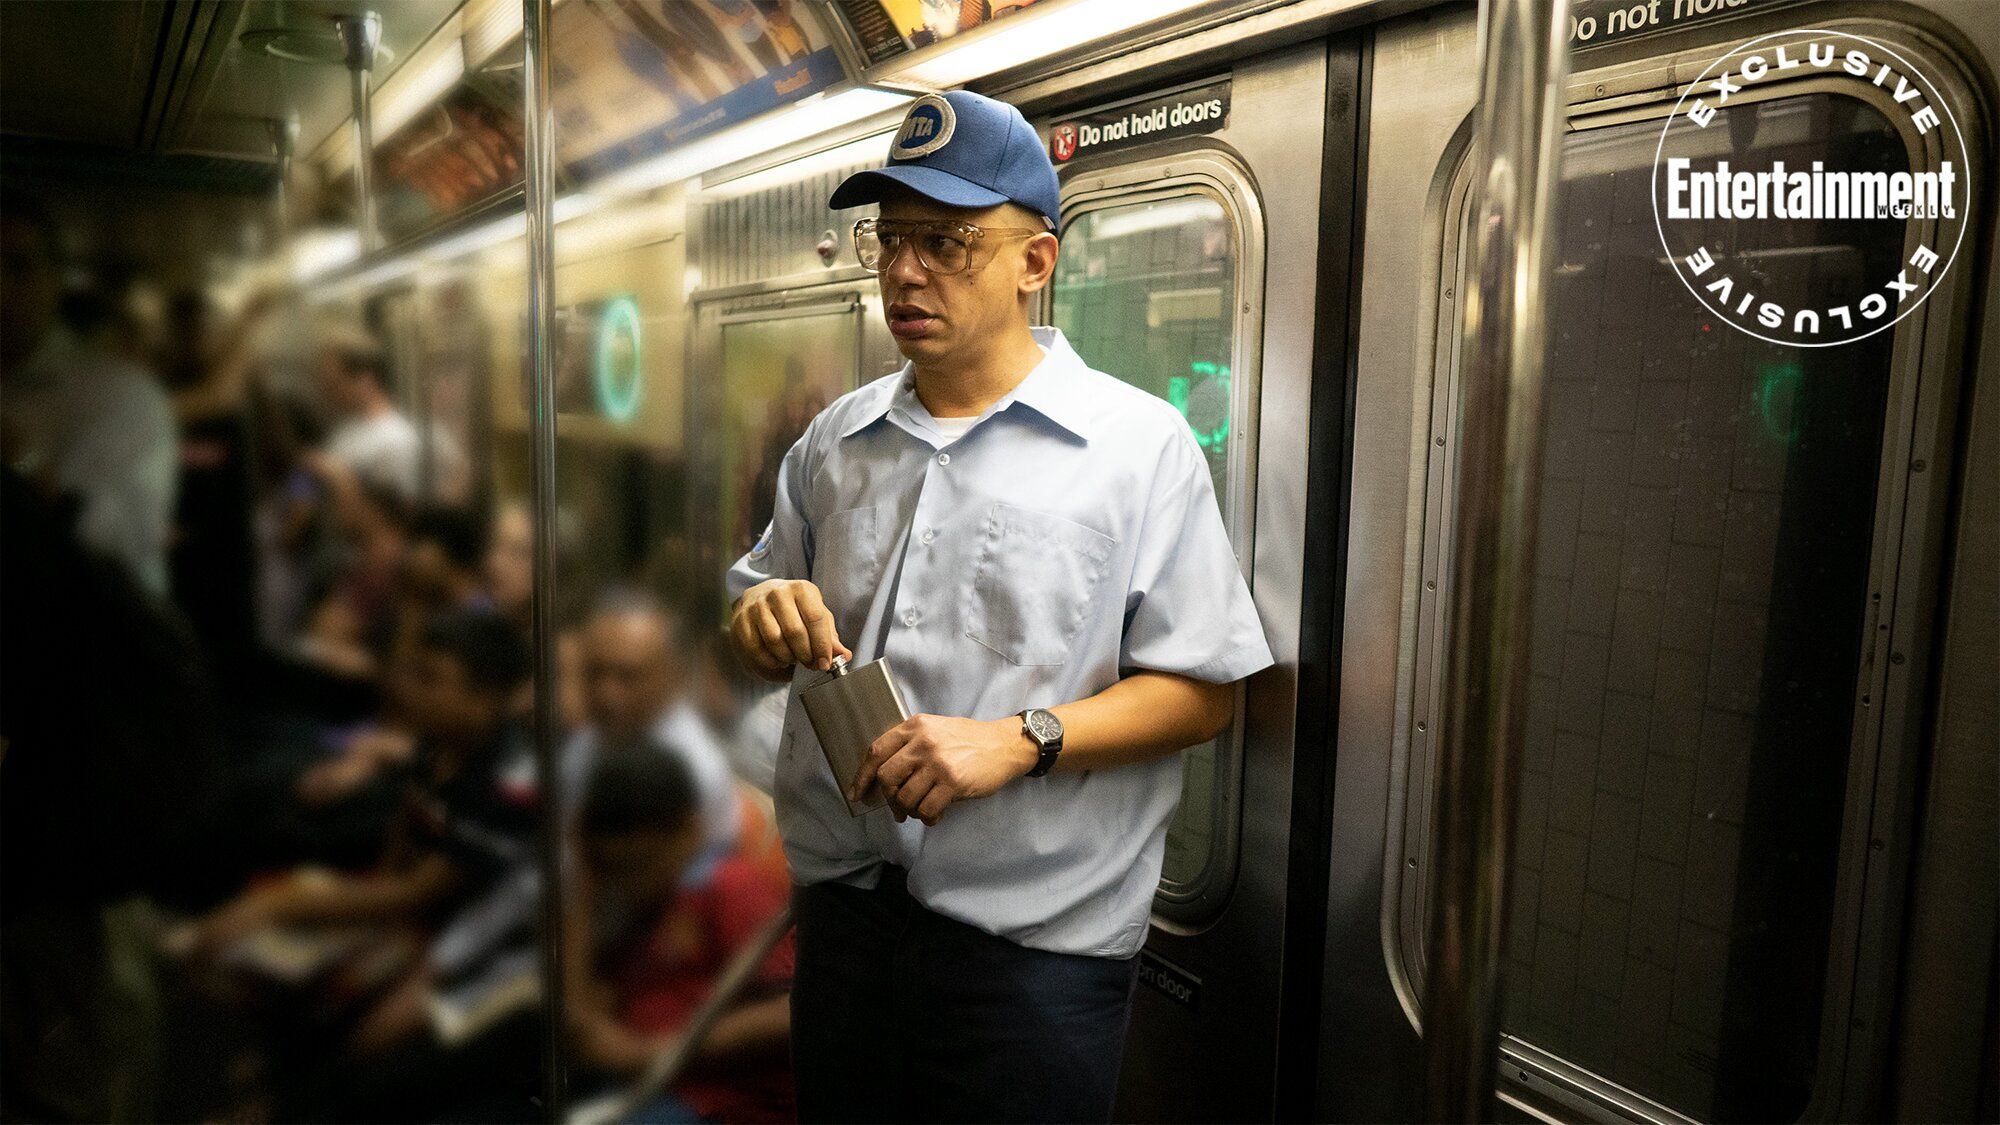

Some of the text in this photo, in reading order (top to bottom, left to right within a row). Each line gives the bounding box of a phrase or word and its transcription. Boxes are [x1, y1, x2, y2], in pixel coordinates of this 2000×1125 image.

[1607, 1, 1660, 34] not
[1673, 0, 1746, 20] ho
[1079, 99, 1222, 147] Do not hold doors
[1157, 971, 1192, 1002] door
